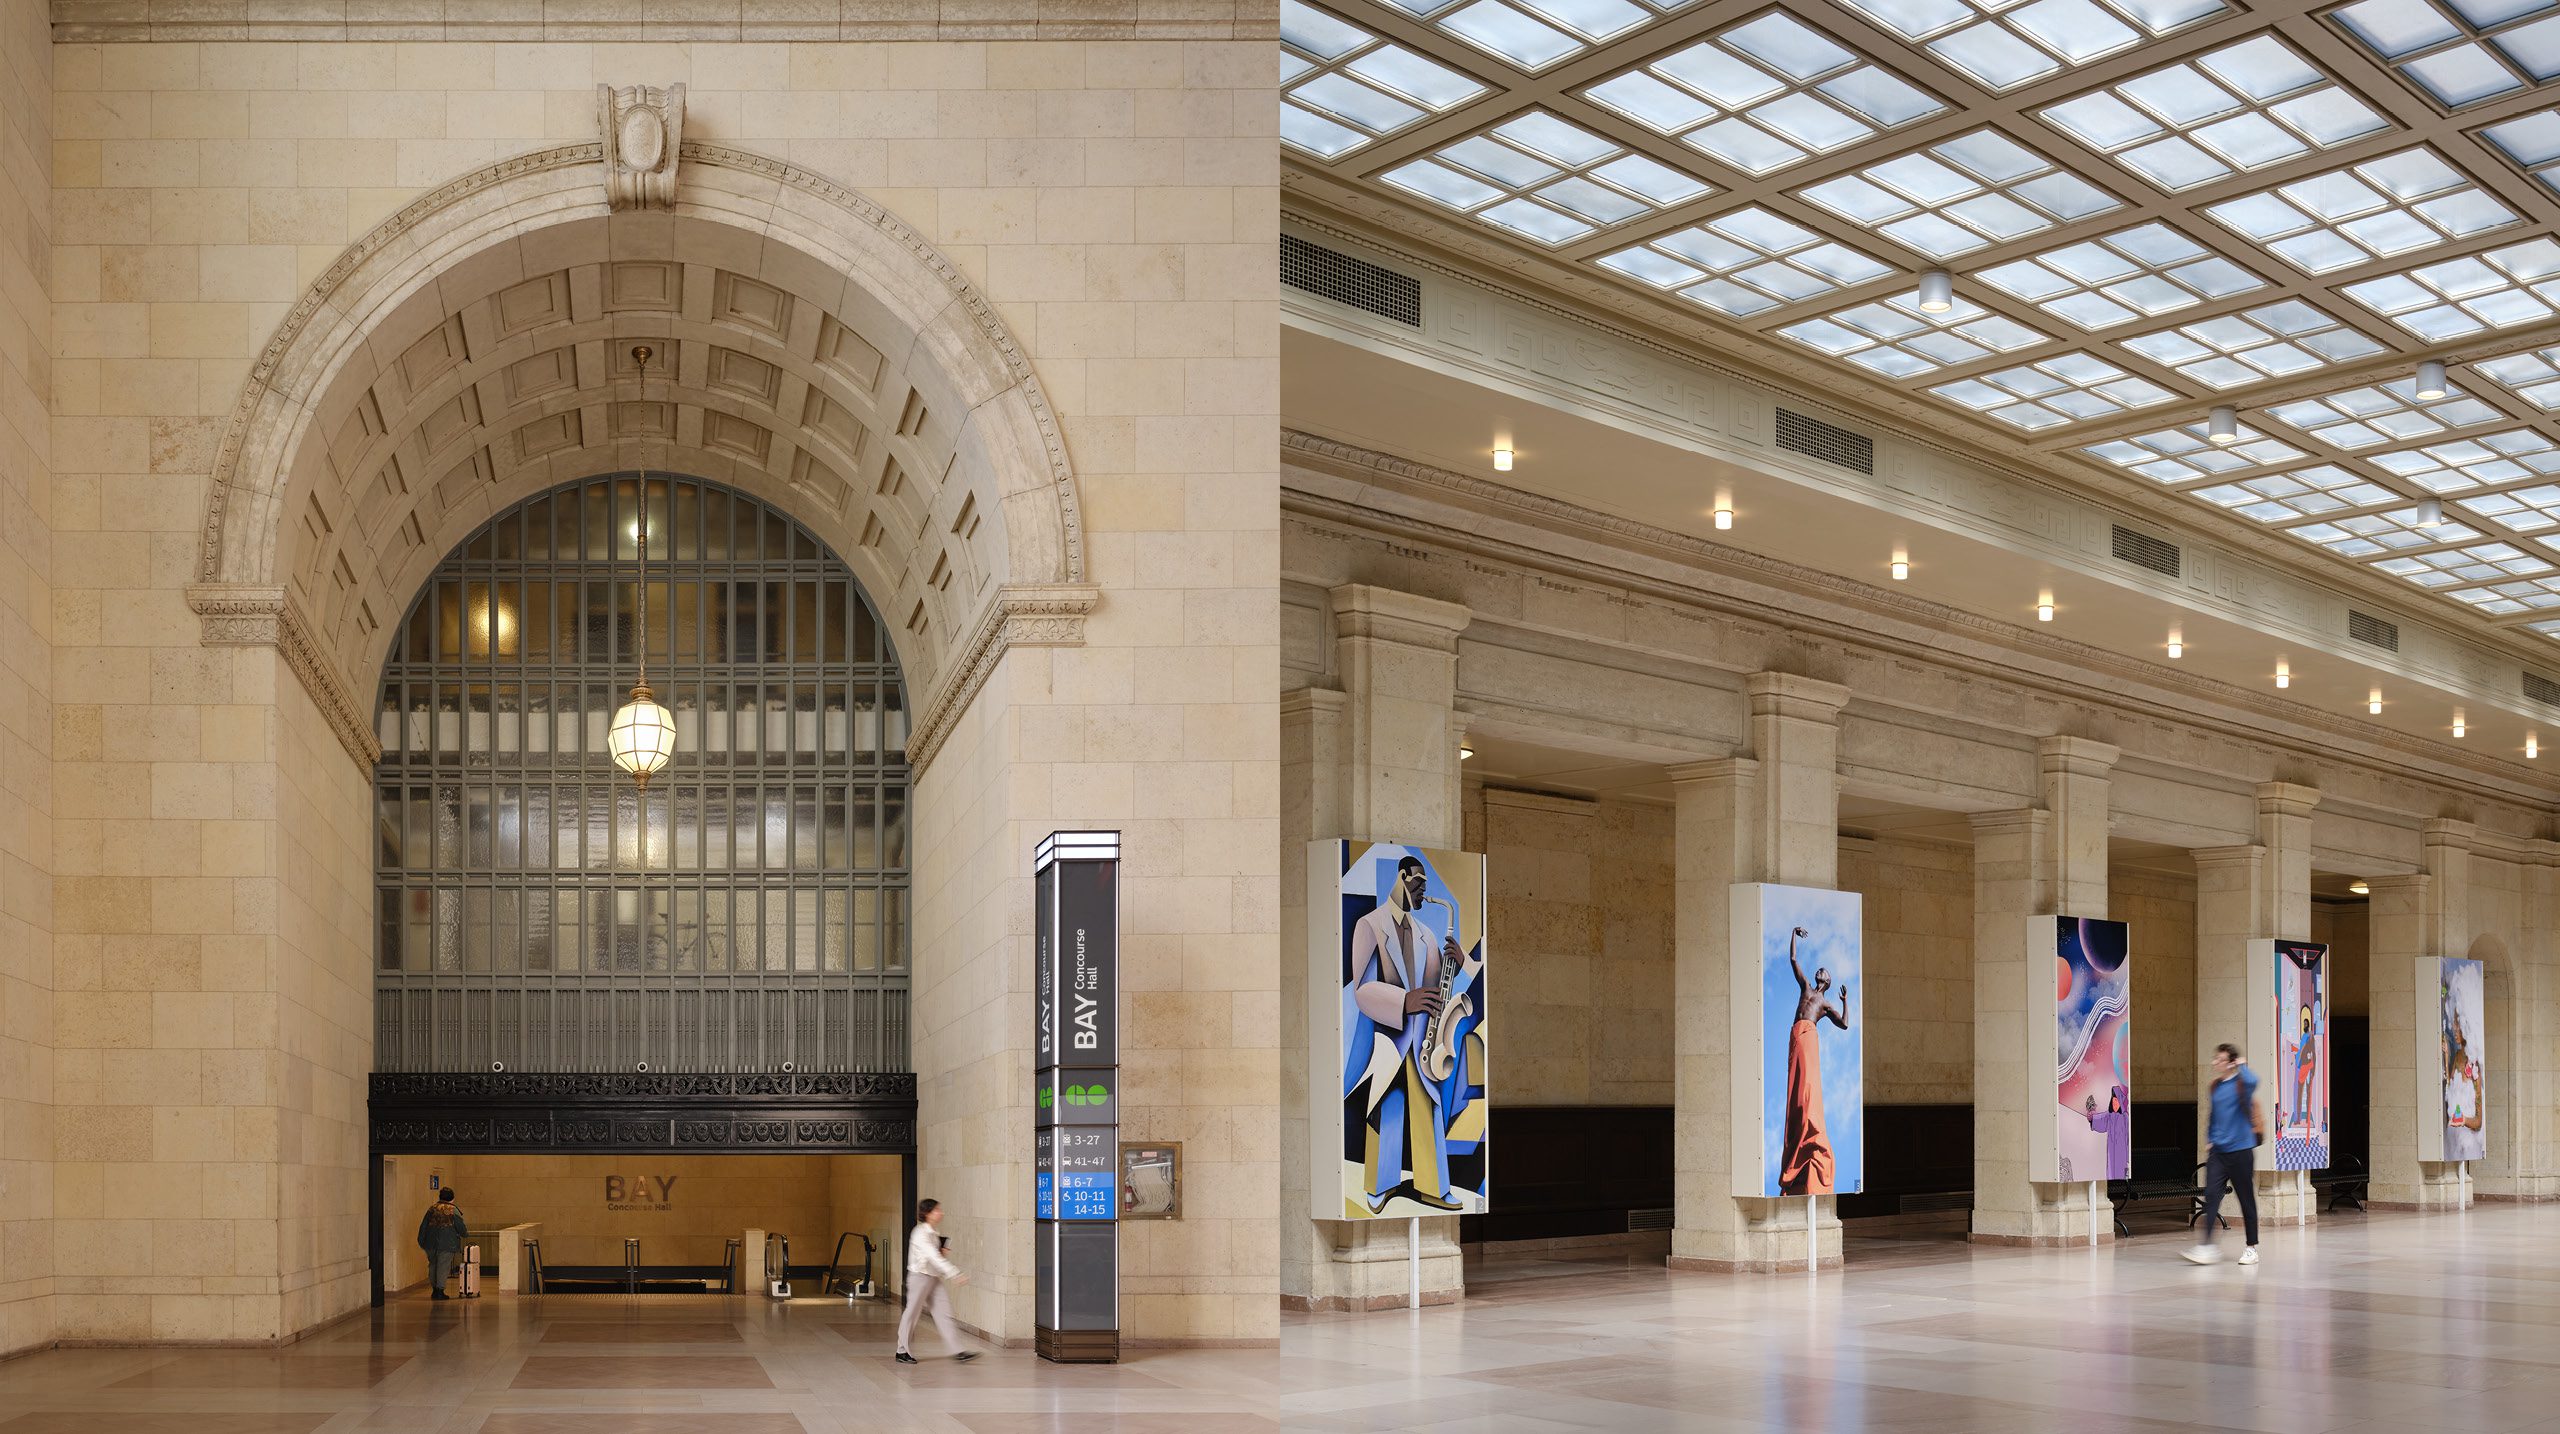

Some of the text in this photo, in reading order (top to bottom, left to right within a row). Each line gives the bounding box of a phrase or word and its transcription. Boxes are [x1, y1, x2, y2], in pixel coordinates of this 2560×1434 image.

[1087, 966, 1097, 990] Hall
[1074, 928, 1097, 1049] BAY Concourse
[1042, 999, 1050, 1054] BAY
[1065, 1084, 1108, 1106] GO
[1074, 1135, 1100, 1146] 3-27
[1074, 1156, 1105, 1166] 41-47
[1074, 1178, 1093, 1187] 6-7
[605, 1175, 677, 1202] BAY
[1074, 1191, 1105, 1201] 10-11
[655, 1203, 672, 1211] Hall
[1074, 1205, 1106, 1214] 14-15
